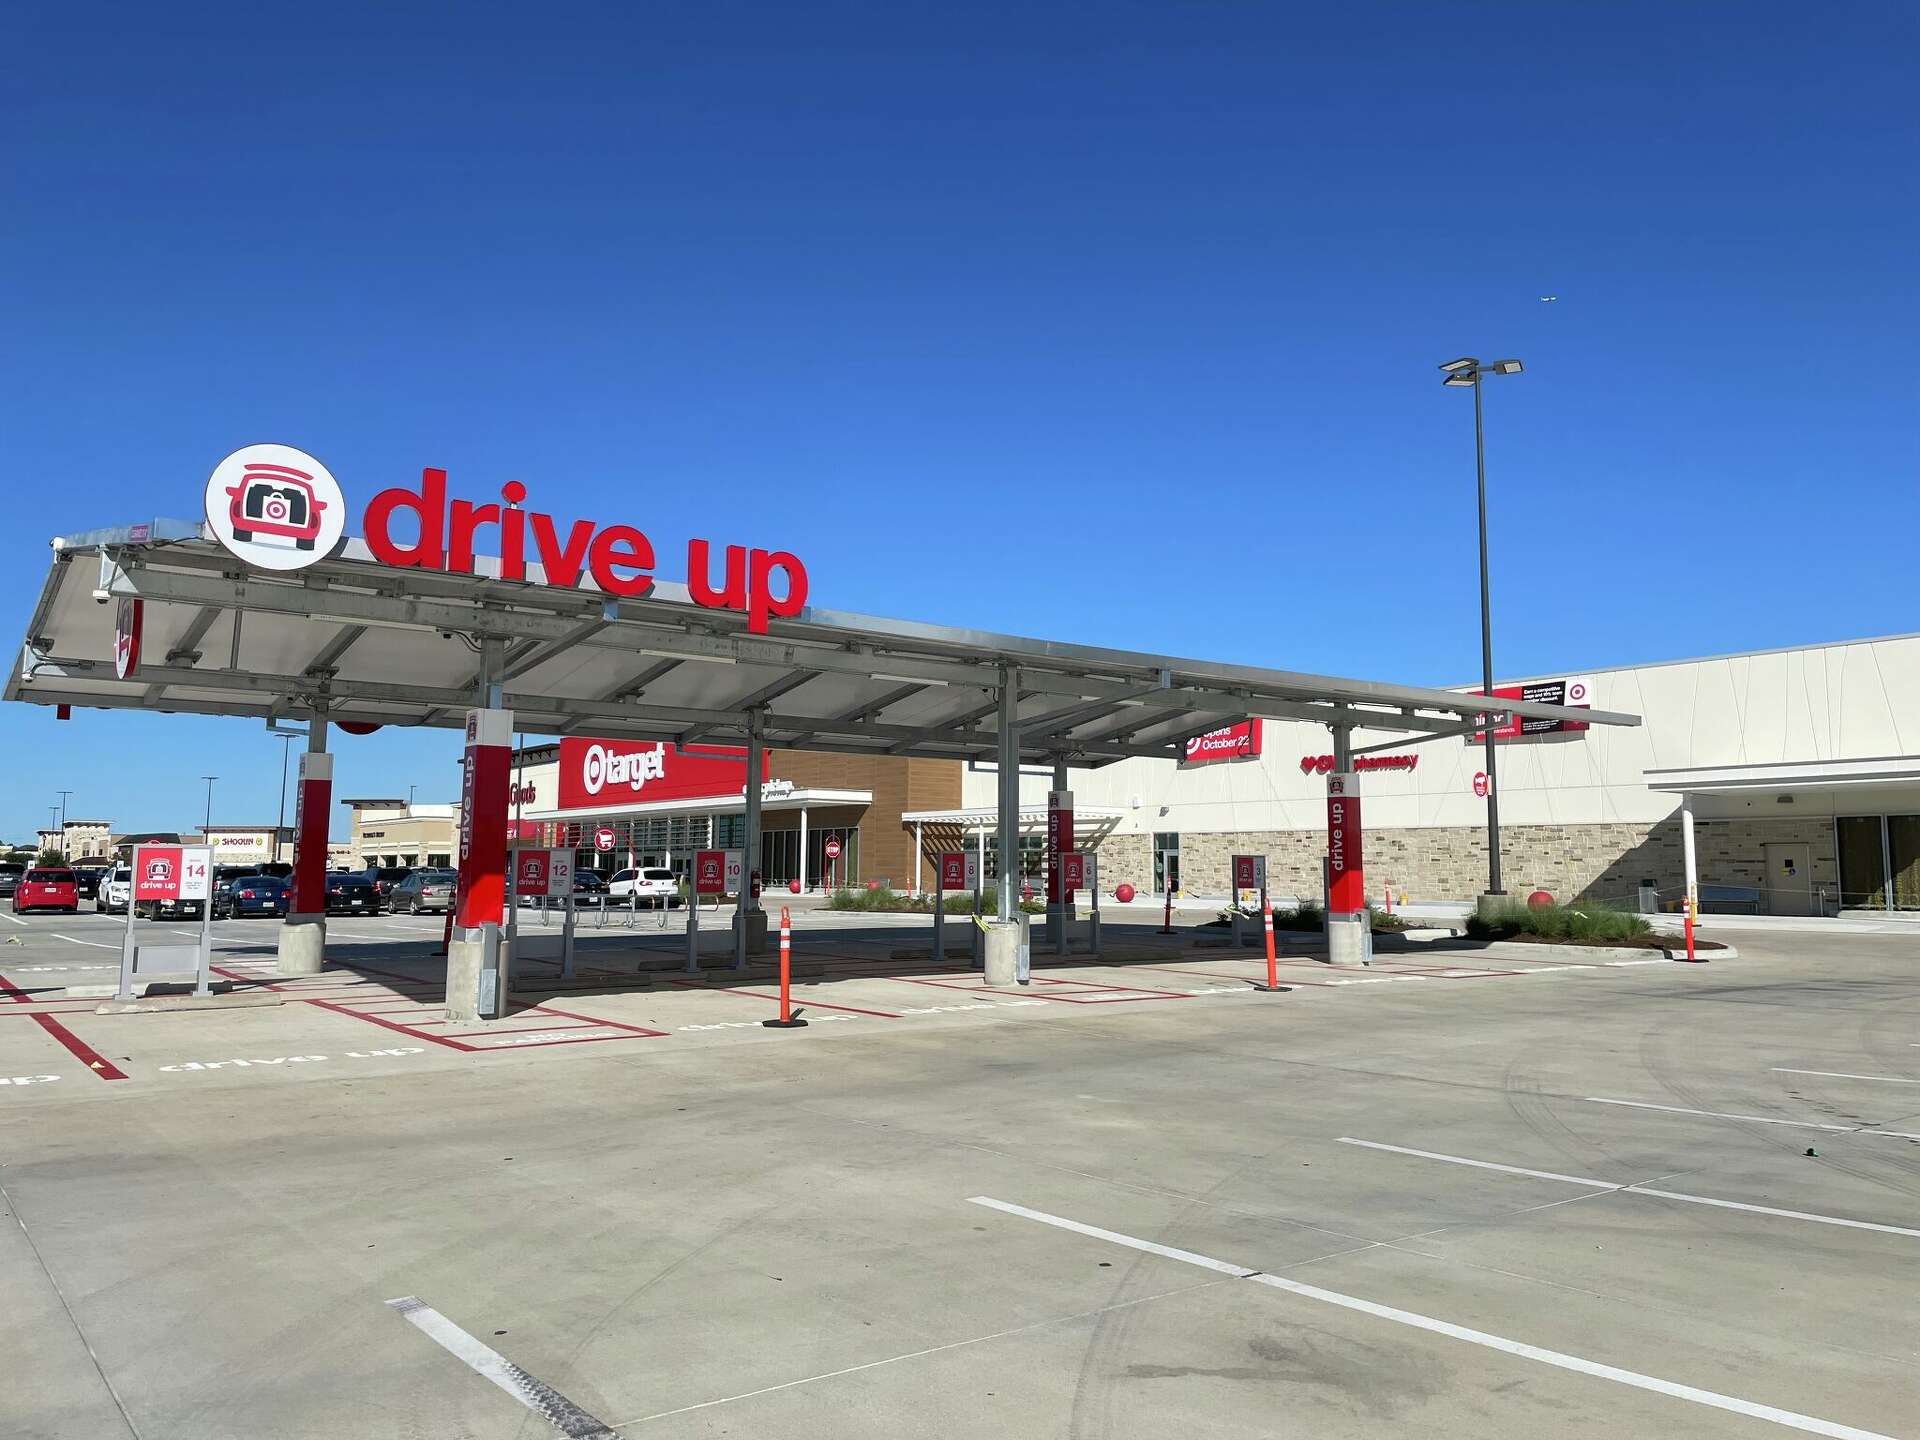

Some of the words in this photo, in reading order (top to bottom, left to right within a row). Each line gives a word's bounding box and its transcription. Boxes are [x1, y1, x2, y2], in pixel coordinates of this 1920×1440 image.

[363, 467, 655, 597] drive
[686, 538, 809, 635] up
[1202, 738, 1238, 750] October
[465, 756, 475, 788] up
[606, 742, 665, 791] target
[1051, 814, 1059, 833] up
[1333, 803, 1345, 824] up
[460, 798, 473, 861] drive
[1050, 837, 1058, 870] drive
[1332, 831, 1344, 871] drive
[186, 864, 206, 878] 14
[552, 864, 568, 877] 12
[727, 864, 740, 876] 10
[968, 865, 975, 875] 8
[1086, 865, 1092, 875] 6
[140, 881, 163, 889] drive
[164, 883, 177, 891] up
[159, 1054, 329, 1073] drive
[345, 1046, 425, 1059] up
